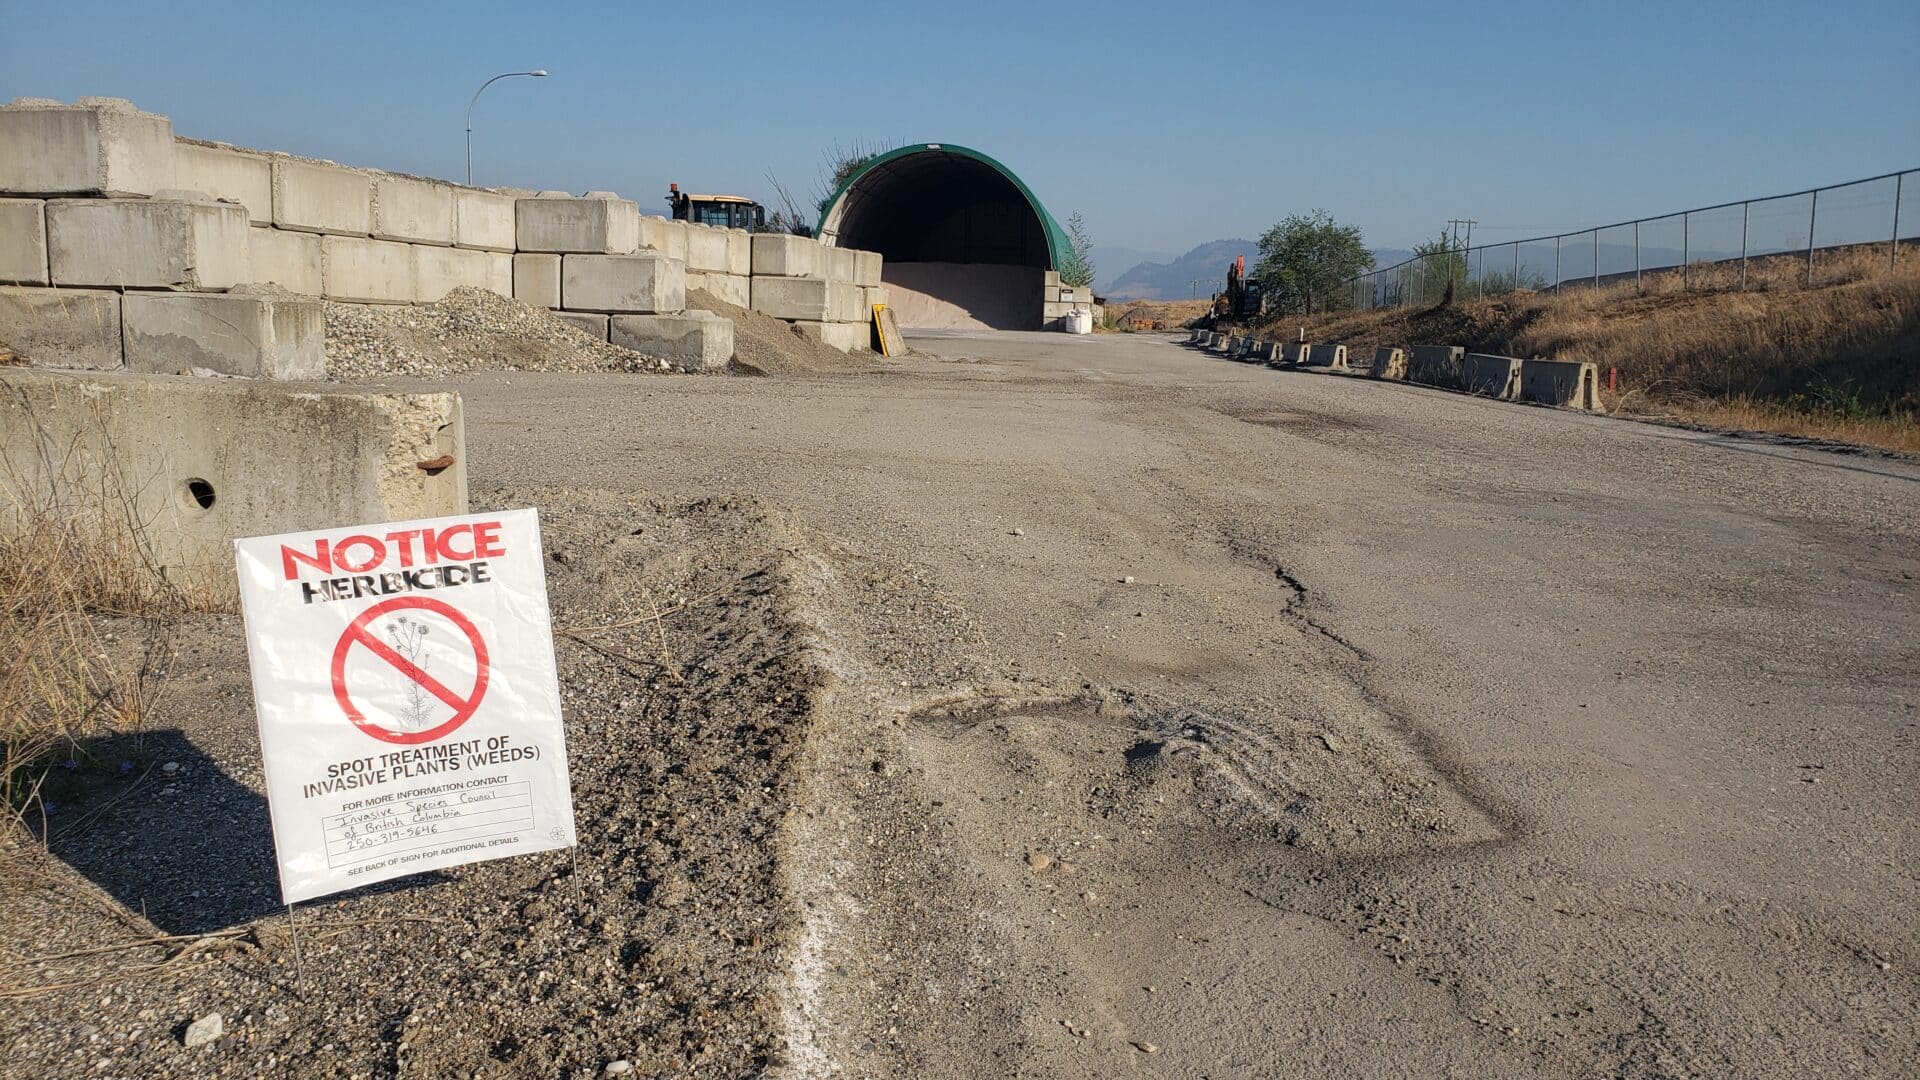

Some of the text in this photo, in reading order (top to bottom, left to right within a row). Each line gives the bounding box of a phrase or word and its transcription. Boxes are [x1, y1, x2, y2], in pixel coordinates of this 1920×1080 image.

[280, 521, 507, 580] NOTICE
[301, 561, 491, 604] HERBICIDE
[303, 745, 540, 798] INVASIVE PLANTS (WEEDS)
[327, 735, 510, 778] SPOT TREATMENT OF
[334, 791, 496, 827] Invasive Species Council
[342, 775, 509, 812] FOR MORE INFORMATION CONTACT
[344, 809, 461, 841] of British Columbia
[346, 824, 438, 850] 250-319-5646
[348, 836, 519, 876] SEE BACK OF SIGN FOR ADDITIONAL DETAILS
